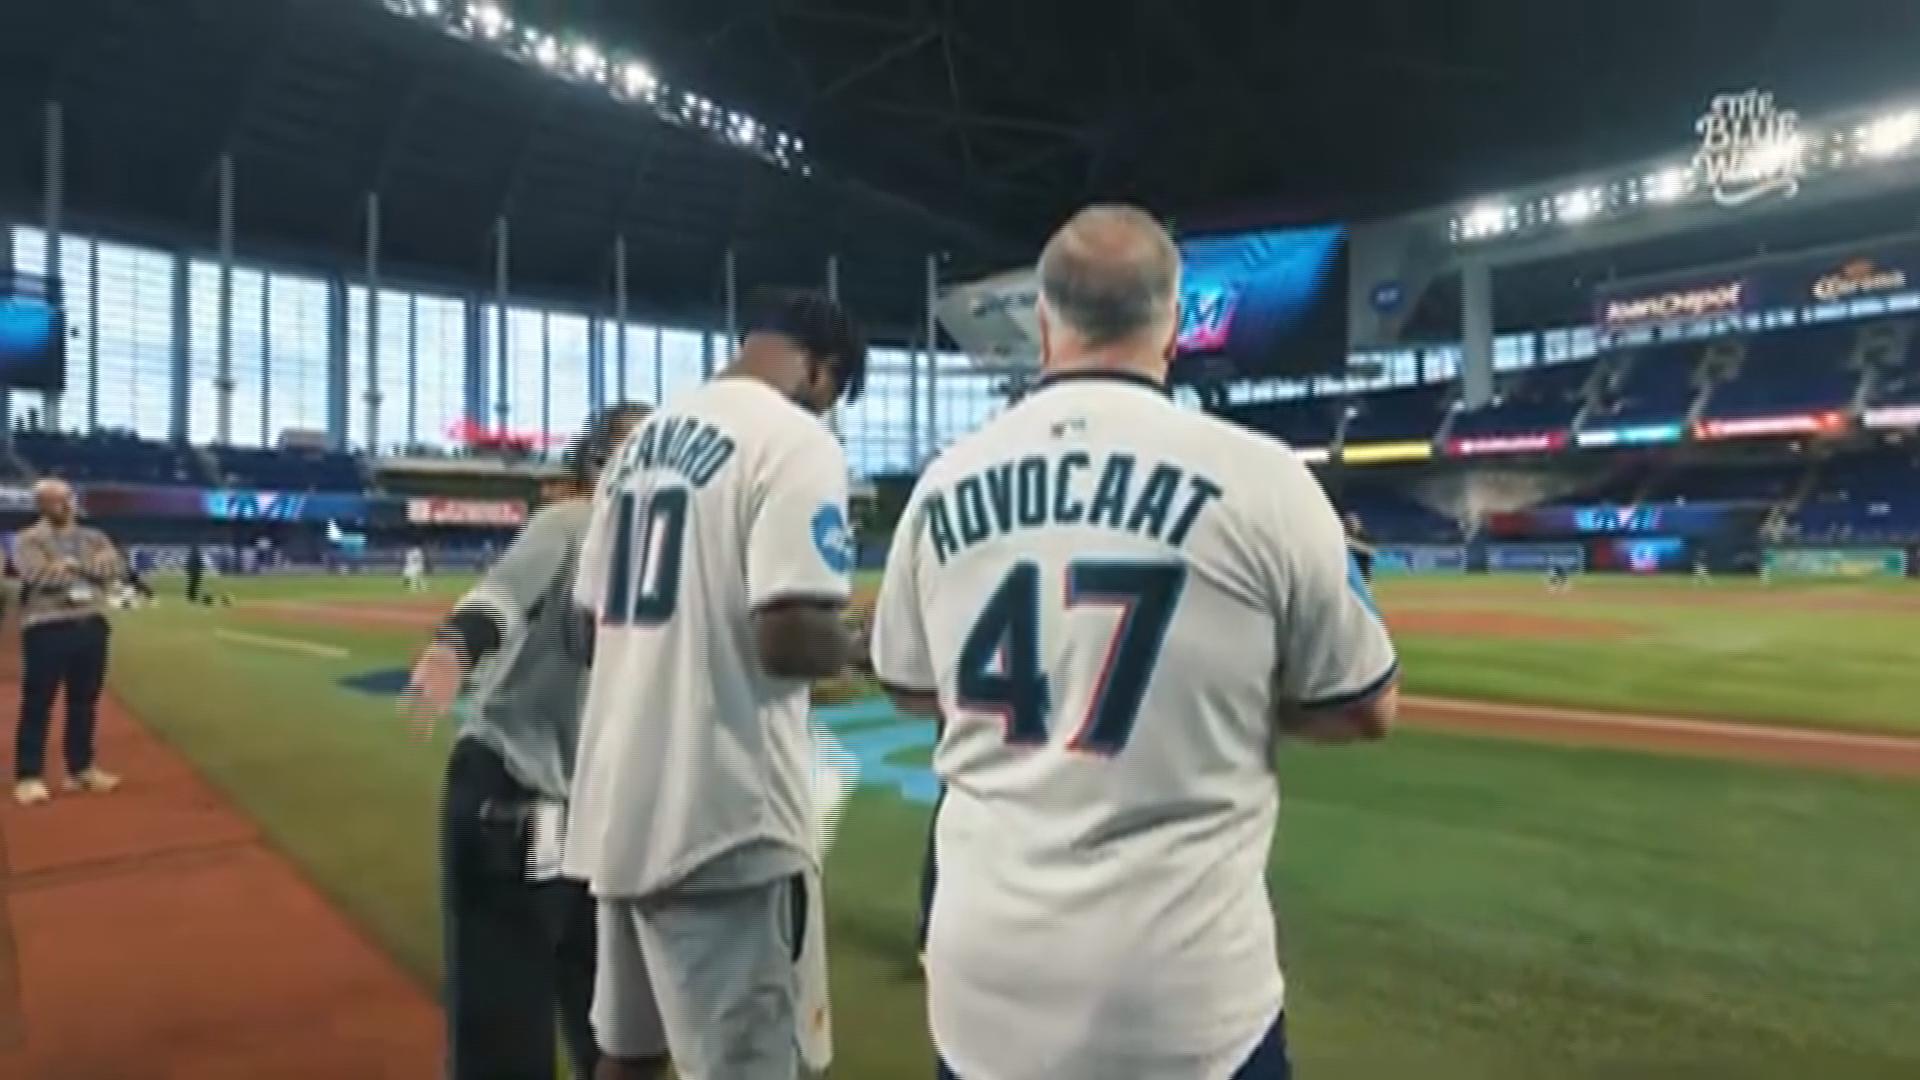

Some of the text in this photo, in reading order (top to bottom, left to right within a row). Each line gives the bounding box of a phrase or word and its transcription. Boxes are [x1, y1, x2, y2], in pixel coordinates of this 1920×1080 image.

[600, 484, 689, 628] 10
[925, 451, 1224, 565] ADVOCAAT
[955, 558, 1190, 758] 47
